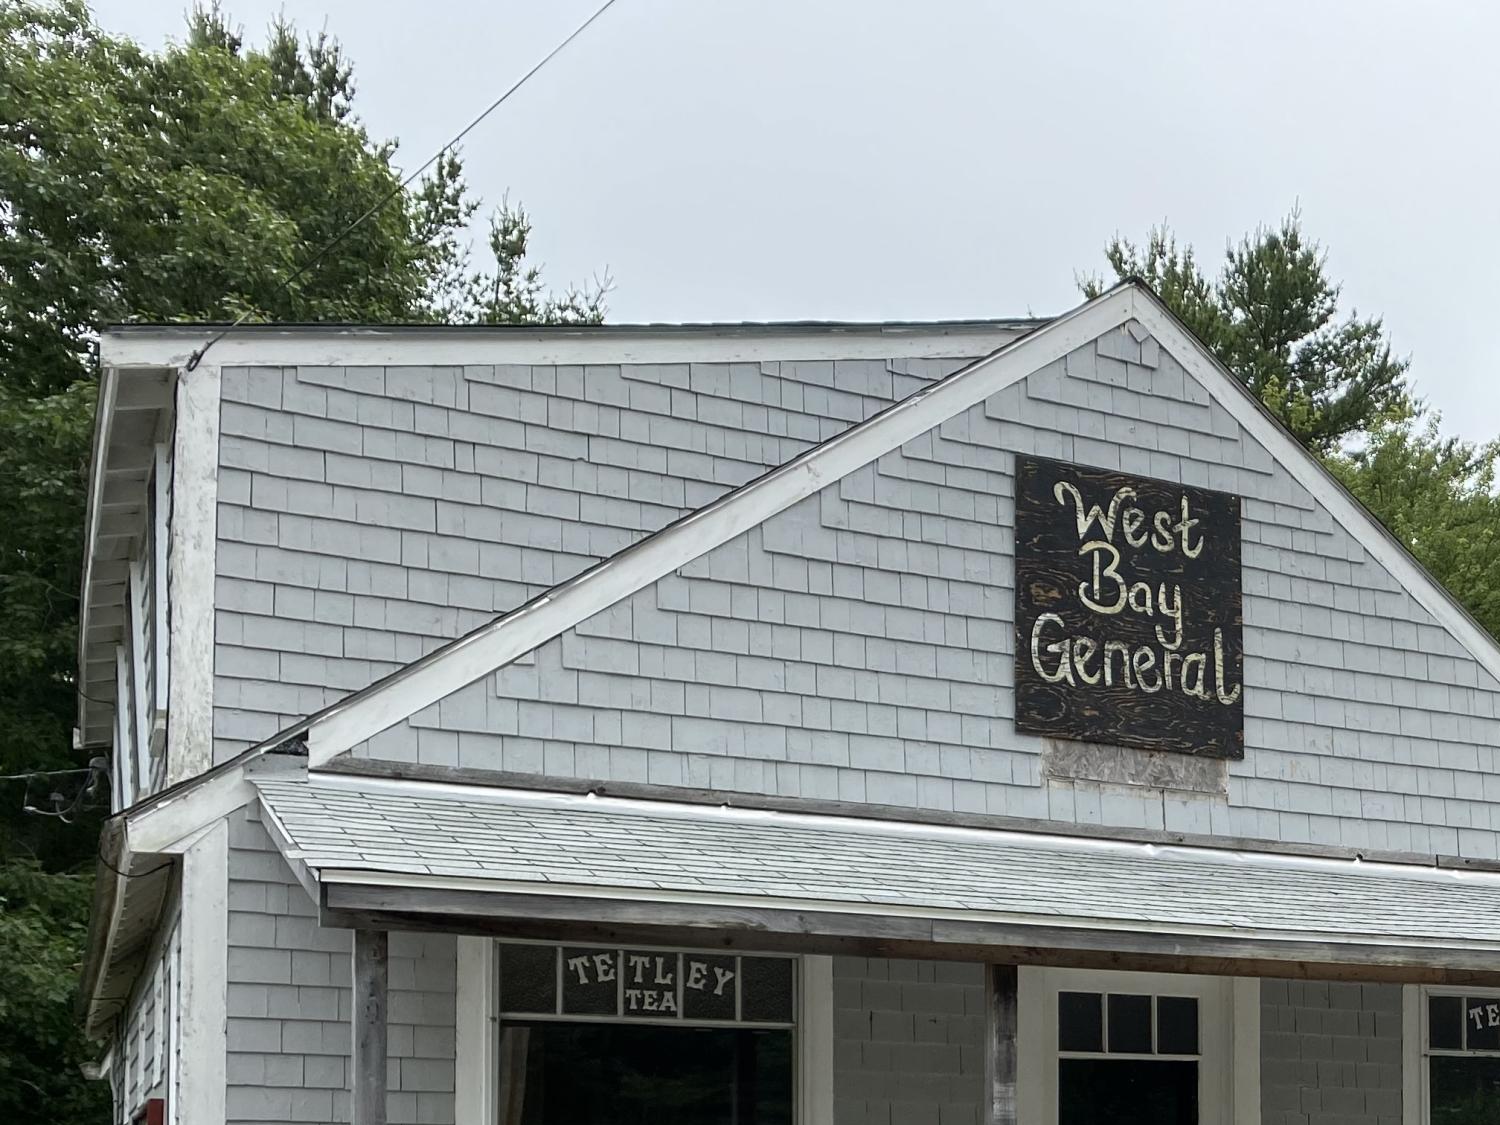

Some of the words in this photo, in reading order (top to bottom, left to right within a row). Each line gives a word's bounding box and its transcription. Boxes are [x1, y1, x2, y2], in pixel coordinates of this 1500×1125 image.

[1053, 481, 1204, 558] West
[1078, 540, 1183, 650] Bay
[1031, 613, 1241, 705] General
[568, 954, 735, 996] TETLEY
[625, 989, 678, 1012] TEA
